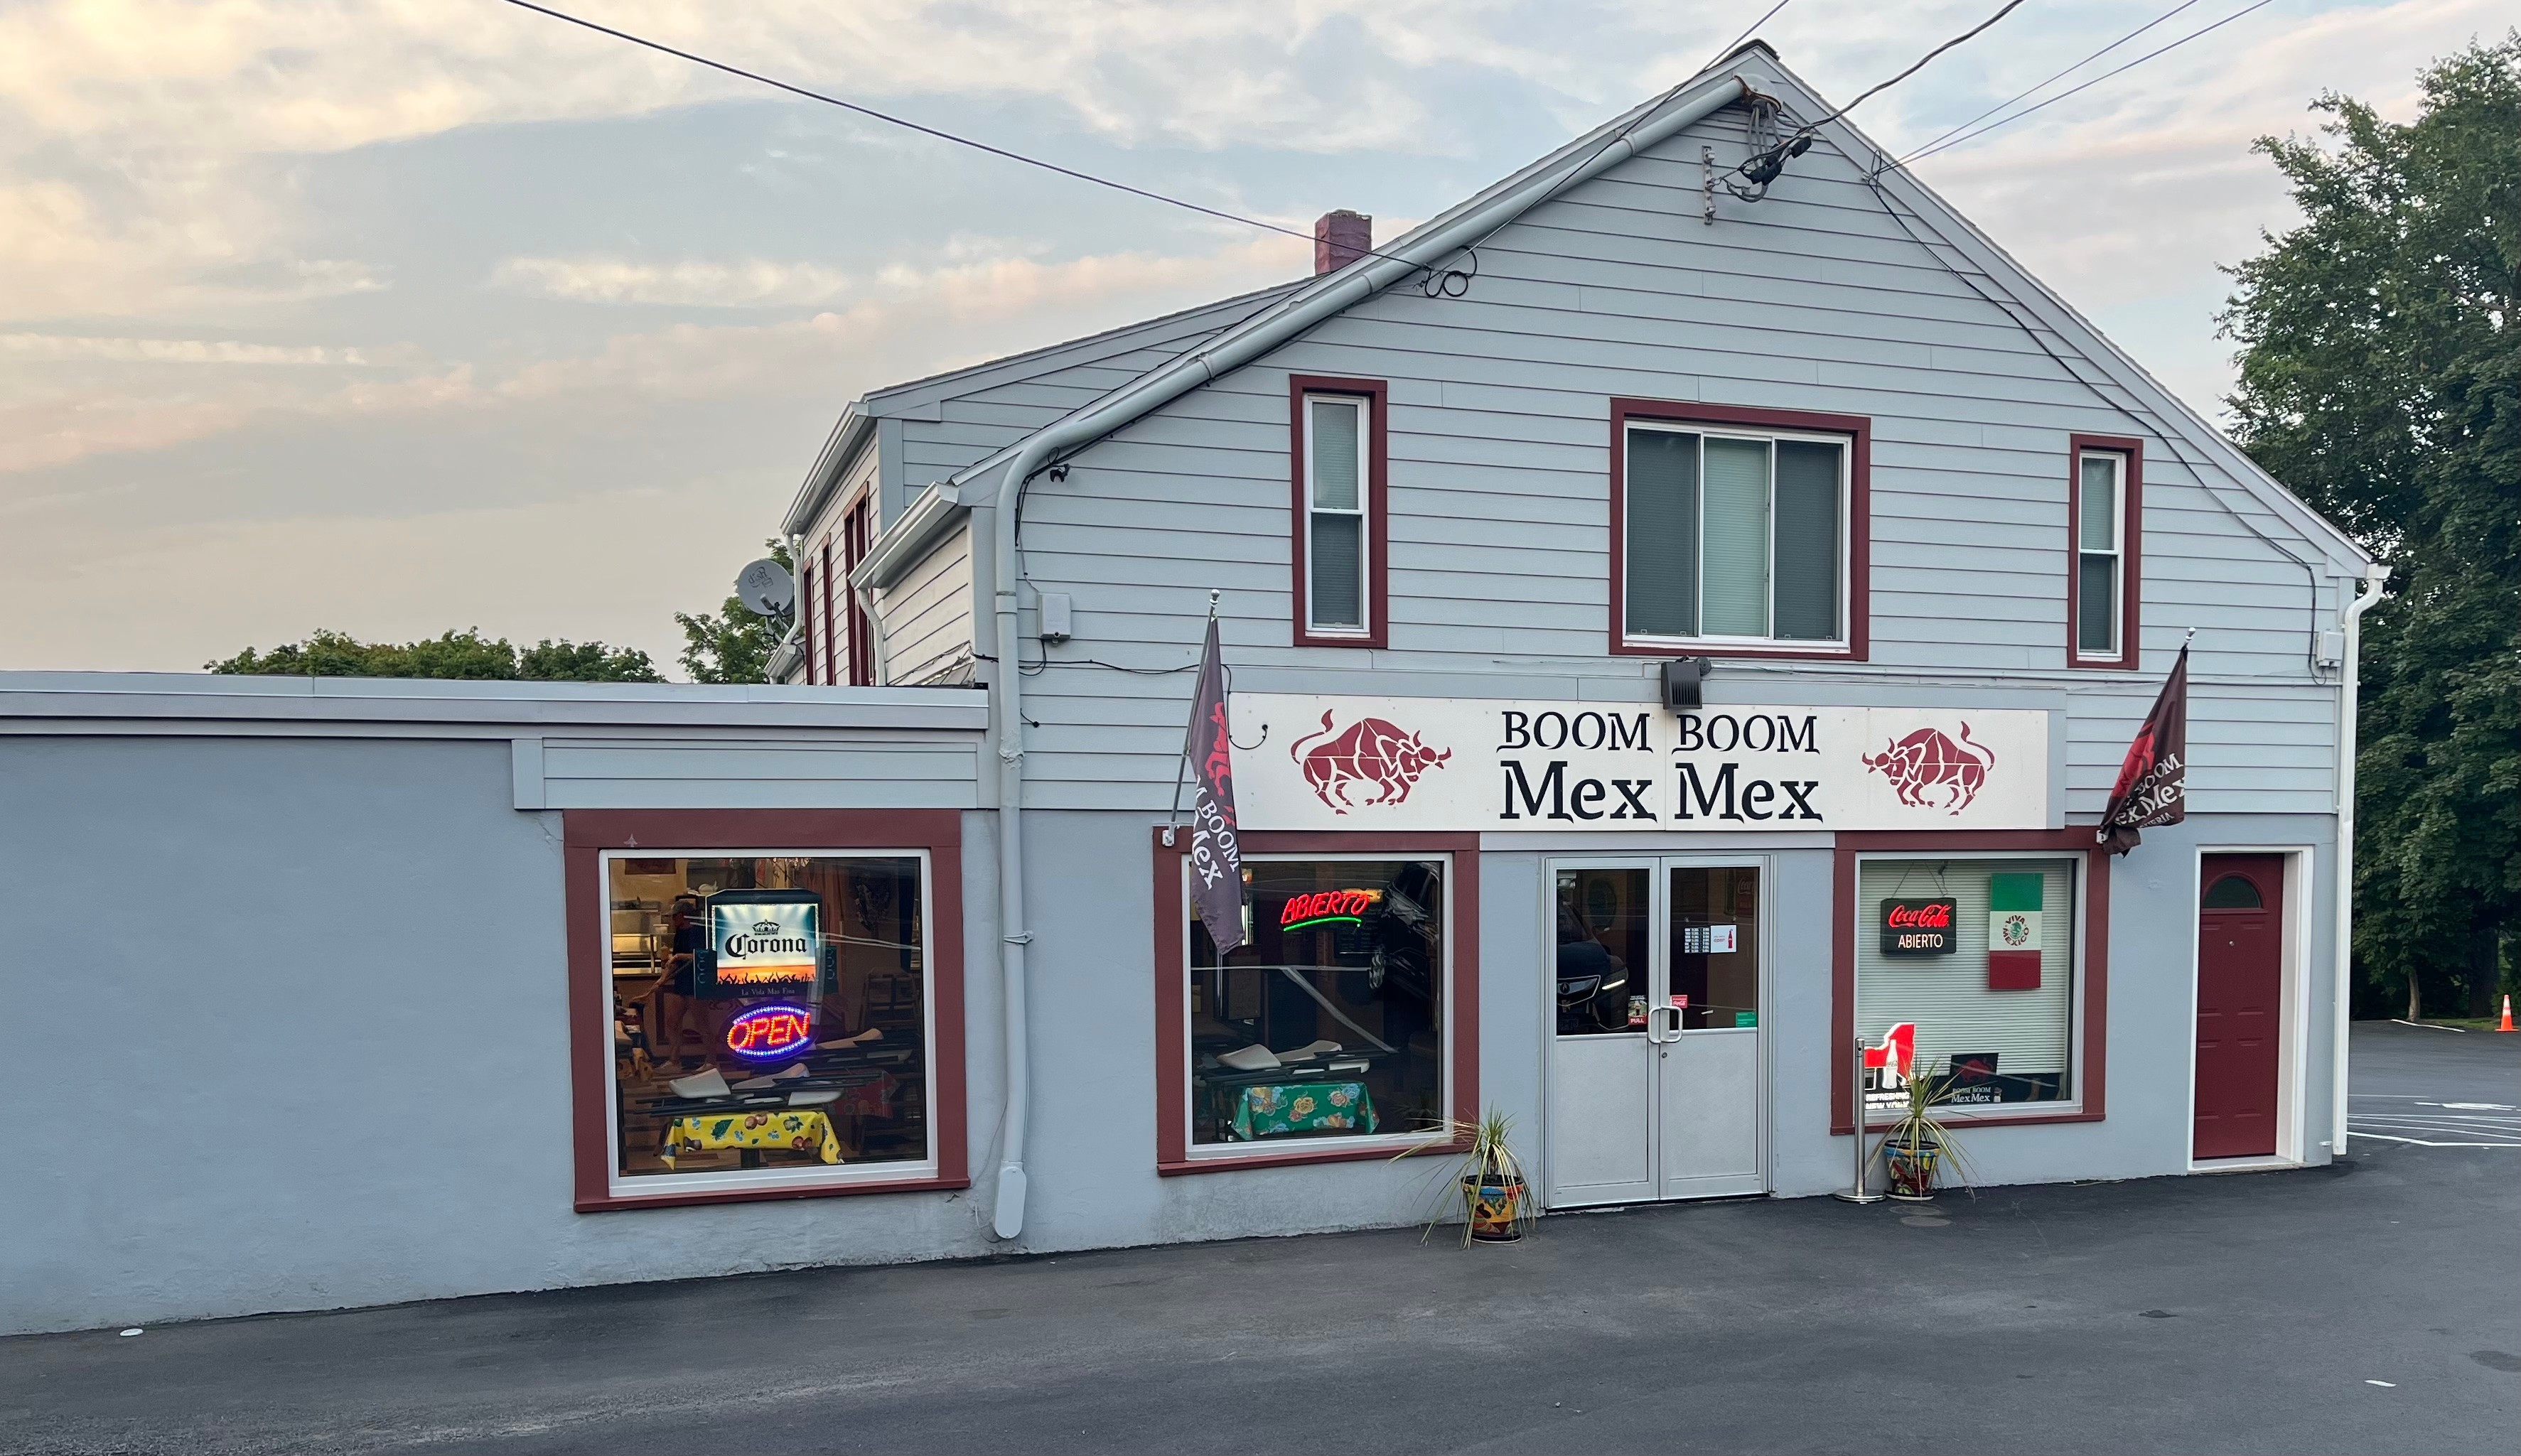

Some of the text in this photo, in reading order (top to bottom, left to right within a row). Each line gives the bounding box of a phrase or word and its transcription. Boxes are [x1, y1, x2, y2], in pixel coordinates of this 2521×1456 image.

[1496, 711, 1820, 755] BOOM BOOM
[1500, 760, 1823, 824] Mex Mex
[2114, 806, 2146, 825] ex
[1198, 800, 1239, 873] BOOM
[1281, 891, 1370, 924] ABIERTO
[1888, 905, 1952, 928] Coca-Cola
[2005, 915, 2025, 924] VIVA
[725, 933, 807, 960] Corona
[1898, 934, 1943, 949] ABIERTO
[2003, 927, 2029, 946] MEXICO
[726, 1011, 811, 1050] OPEN
[1951, 1093, 1991, 1104] Mex Mex
